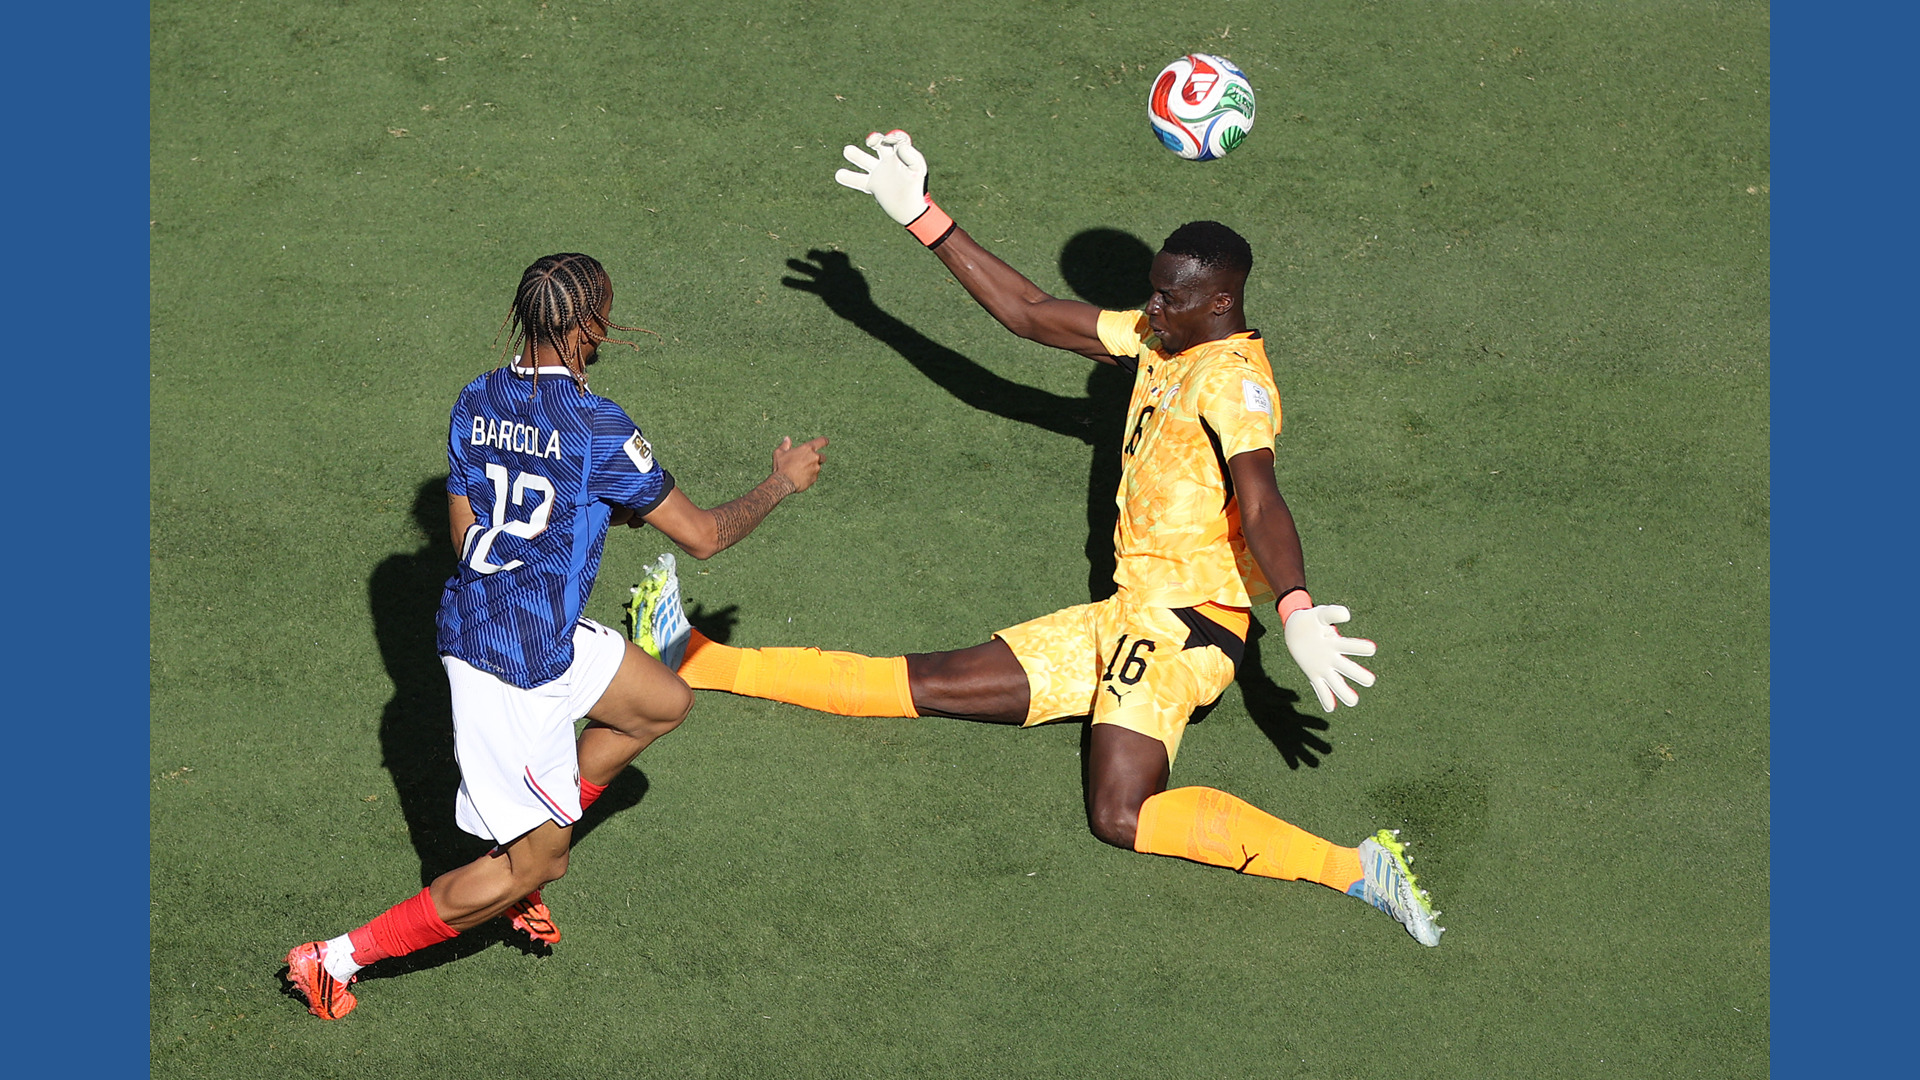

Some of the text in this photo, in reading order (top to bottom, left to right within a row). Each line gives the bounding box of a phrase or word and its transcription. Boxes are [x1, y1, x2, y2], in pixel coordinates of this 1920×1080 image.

[471, 415, 562, 461] BARCOLA
[1124, 405, 1156, 456] 6
[462, 462, 556, 575] 12
[1102, 633, 1156, 686] 16
